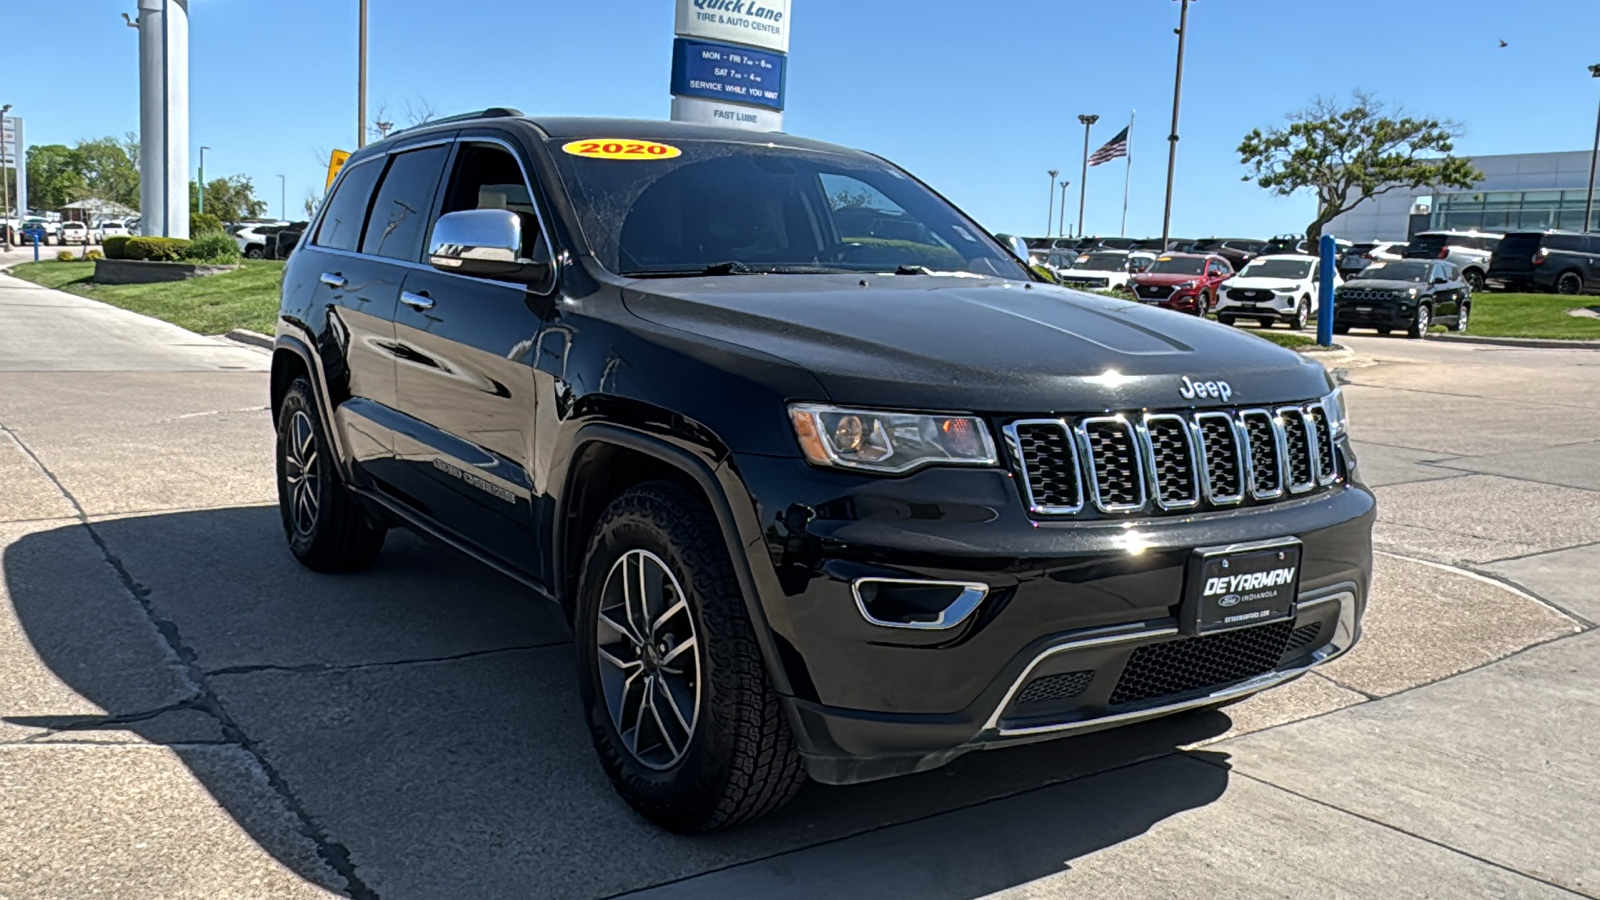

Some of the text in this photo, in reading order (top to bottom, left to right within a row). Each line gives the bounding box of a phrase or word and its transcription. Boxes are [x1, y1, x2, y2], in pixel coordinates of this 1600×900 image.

[694, 0, 783, 22] Quick Lane
[696, 12, 780, 35] TIRE & AUTO CENTER
[702, 51, 720, 60] MON
[729, 54, 741, 63] FRI
[714, 67, 728, 76] SAT
[689, 80, 778, 100] SERVICE WHILE YOU WAIT
[714, 109, 757, 123] FAST LUBE
[578, 143, 667, 155] 2020
[1180, 375, 1232, 402] Jeep
[1203, 567, 1295, 596] DEYARMAN
[1241, 590, 1278, 602] INDIANOLA
